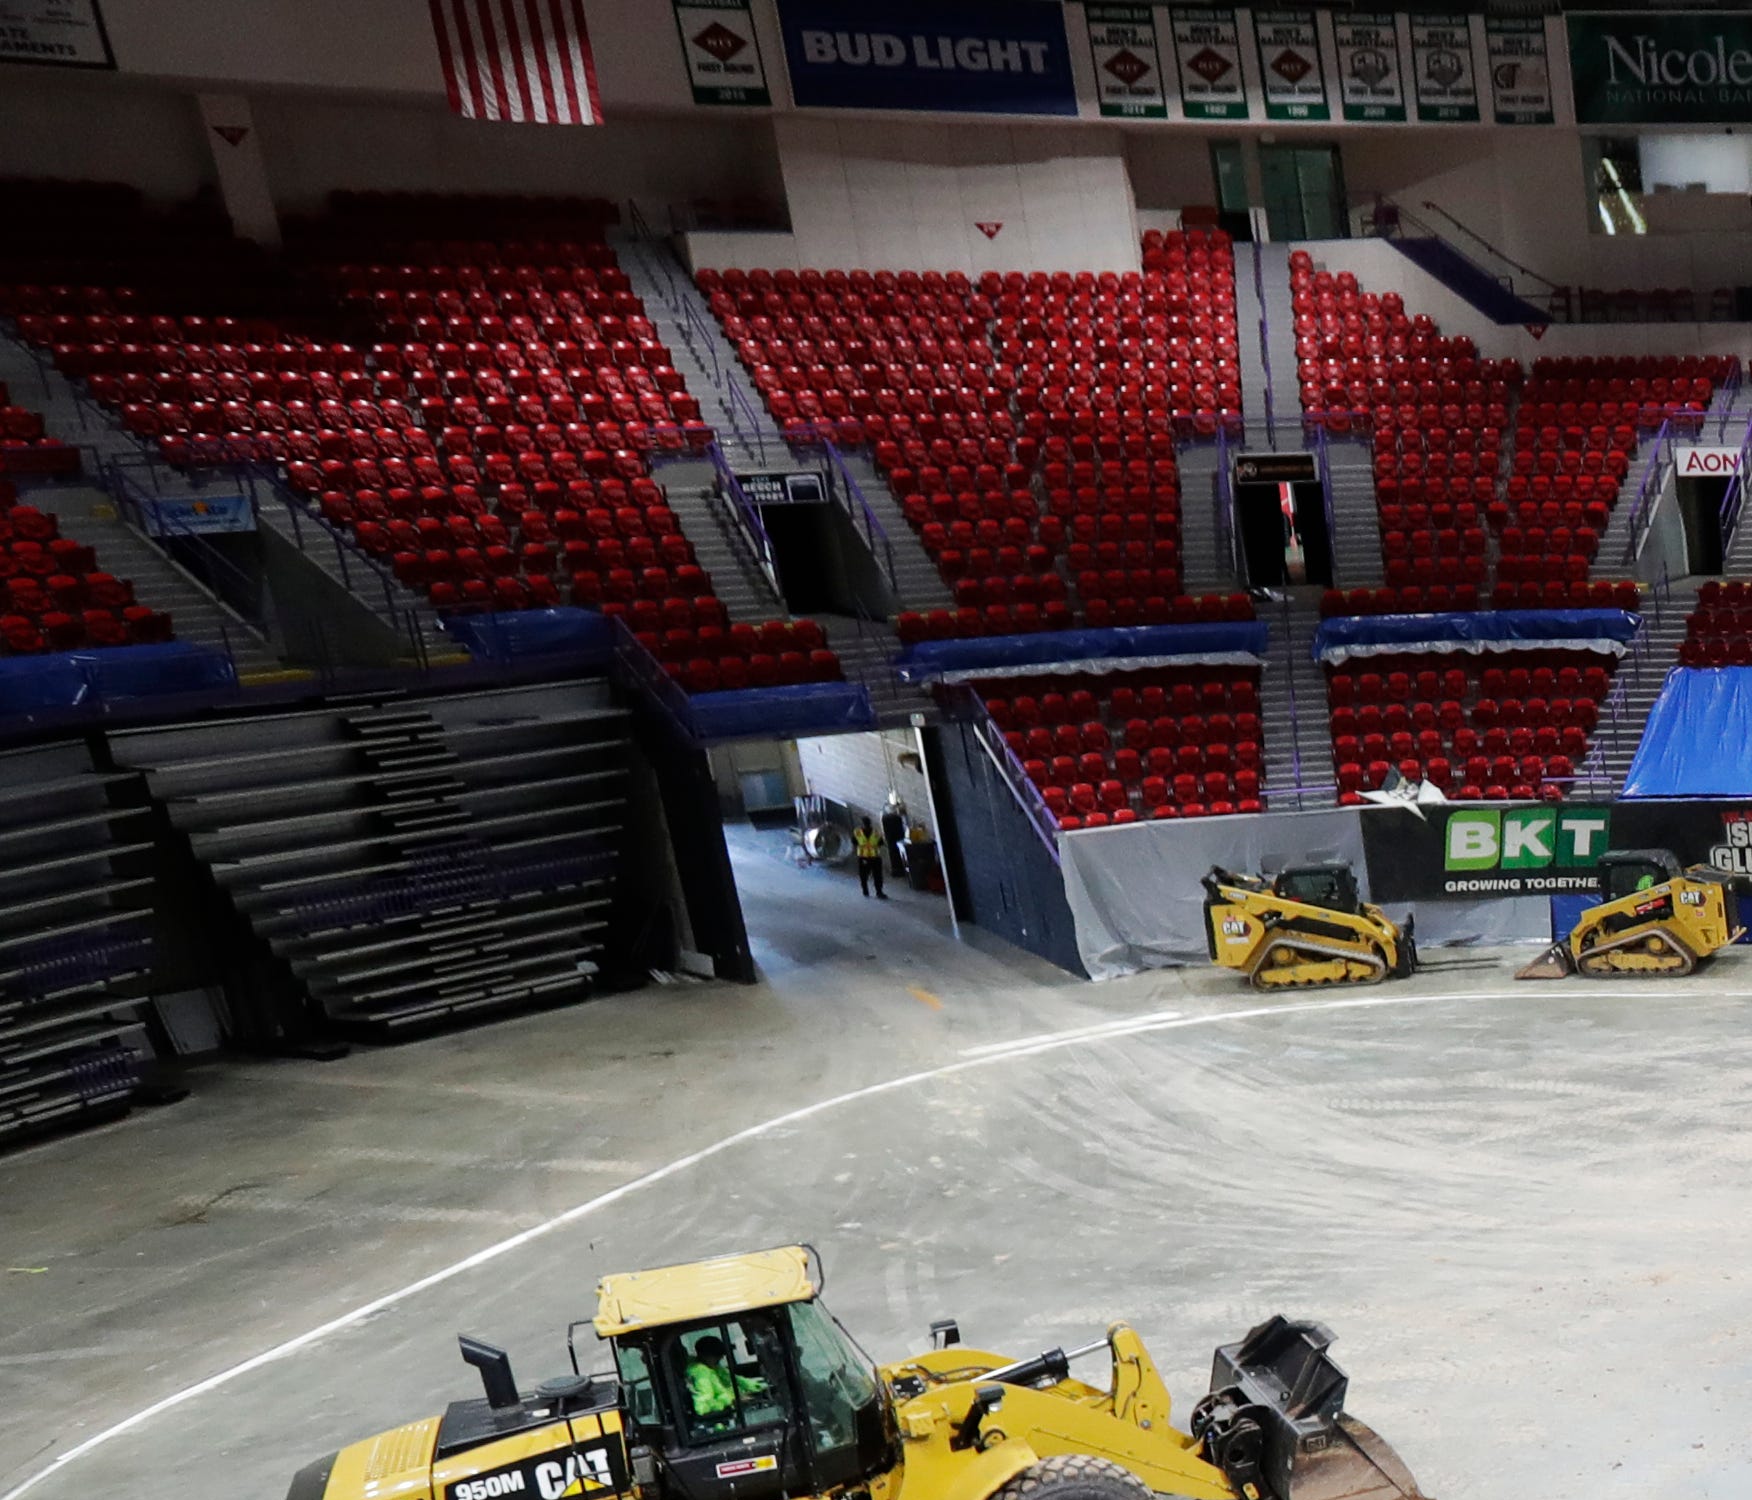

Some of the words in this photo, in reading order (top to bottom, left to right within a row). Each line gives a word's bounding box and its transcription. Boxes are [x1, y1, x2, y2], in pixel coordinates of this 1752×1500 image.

[0, 40, 77, 56] AMENTS
[801, 29, 907, 67] BUD
[912, 34, 1049, 75] LIGHT
[1686, 451, 1739, 472] AON
[1449, 818, 1606, 861] BKT
[1445, 878, 1521, 893] GROWING
[1525, 876, 1601, 890] TOGETHE
[1680, 890, 1700, 905] CAT
[1222, 920, 1246, 936] CAT
[535, 1448, 613, 1500] CAT
